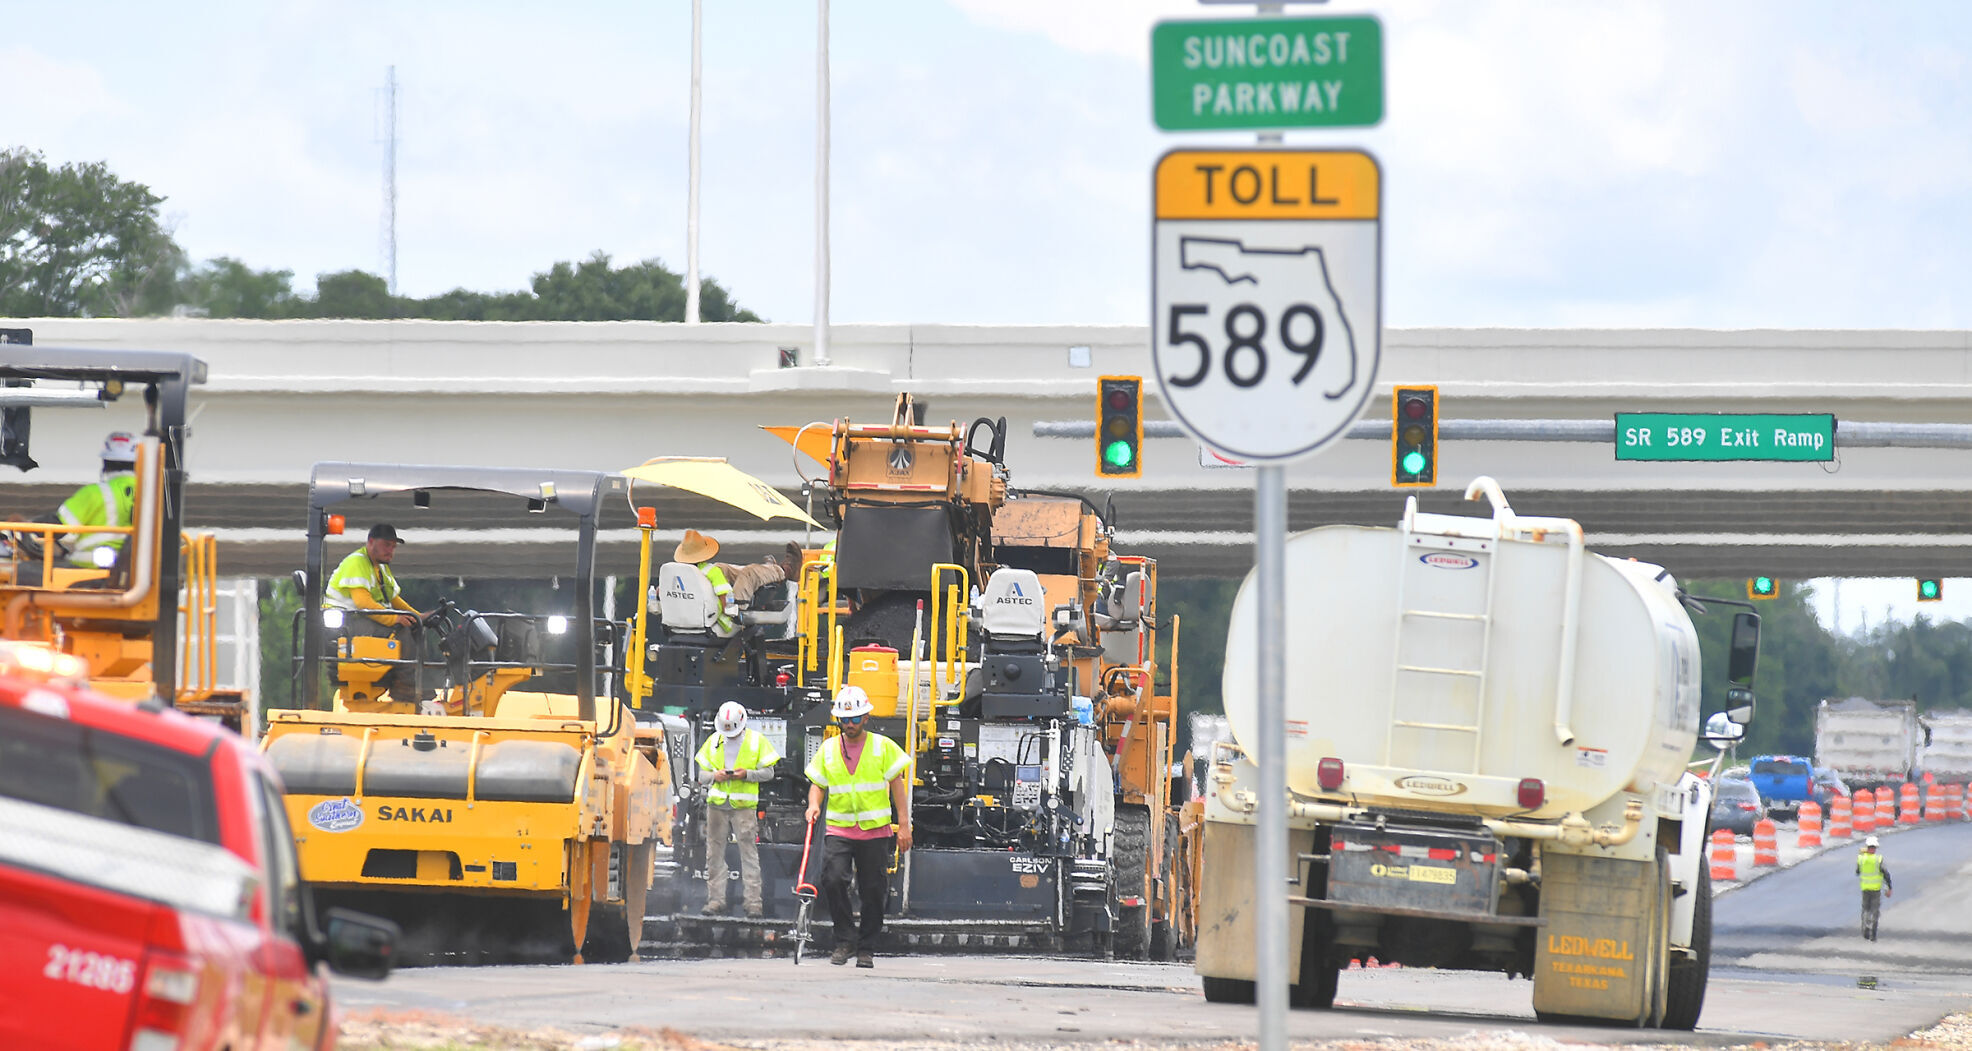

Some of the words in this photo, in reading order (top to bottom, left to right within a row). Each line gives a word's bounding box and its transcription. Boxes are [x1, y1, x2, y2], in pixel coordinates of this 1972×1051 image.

[1184, 32, 1351, 69] SUNCOAST
[1192, 80, 1343, 115] PARKWAY
[1195, 164, 1340, 206] TOLL
[1168, 303, 1325, 388] 589
[1625, 428, 1652, 446] SR
[1667, 427, 1706, 446] 589
[1720, 428, 1759, 447] Exit
[1774, 429, 1824, 451] Ramp
[666, 591, 695, 600] ASTEC
[996, 596, 1033, 605] ASTEC
[377, 805, 453, 823] SAKAI
[1548, 935, 1634, 961] LEDWELL
[1569, 976, 1609, 991] TEXAS
